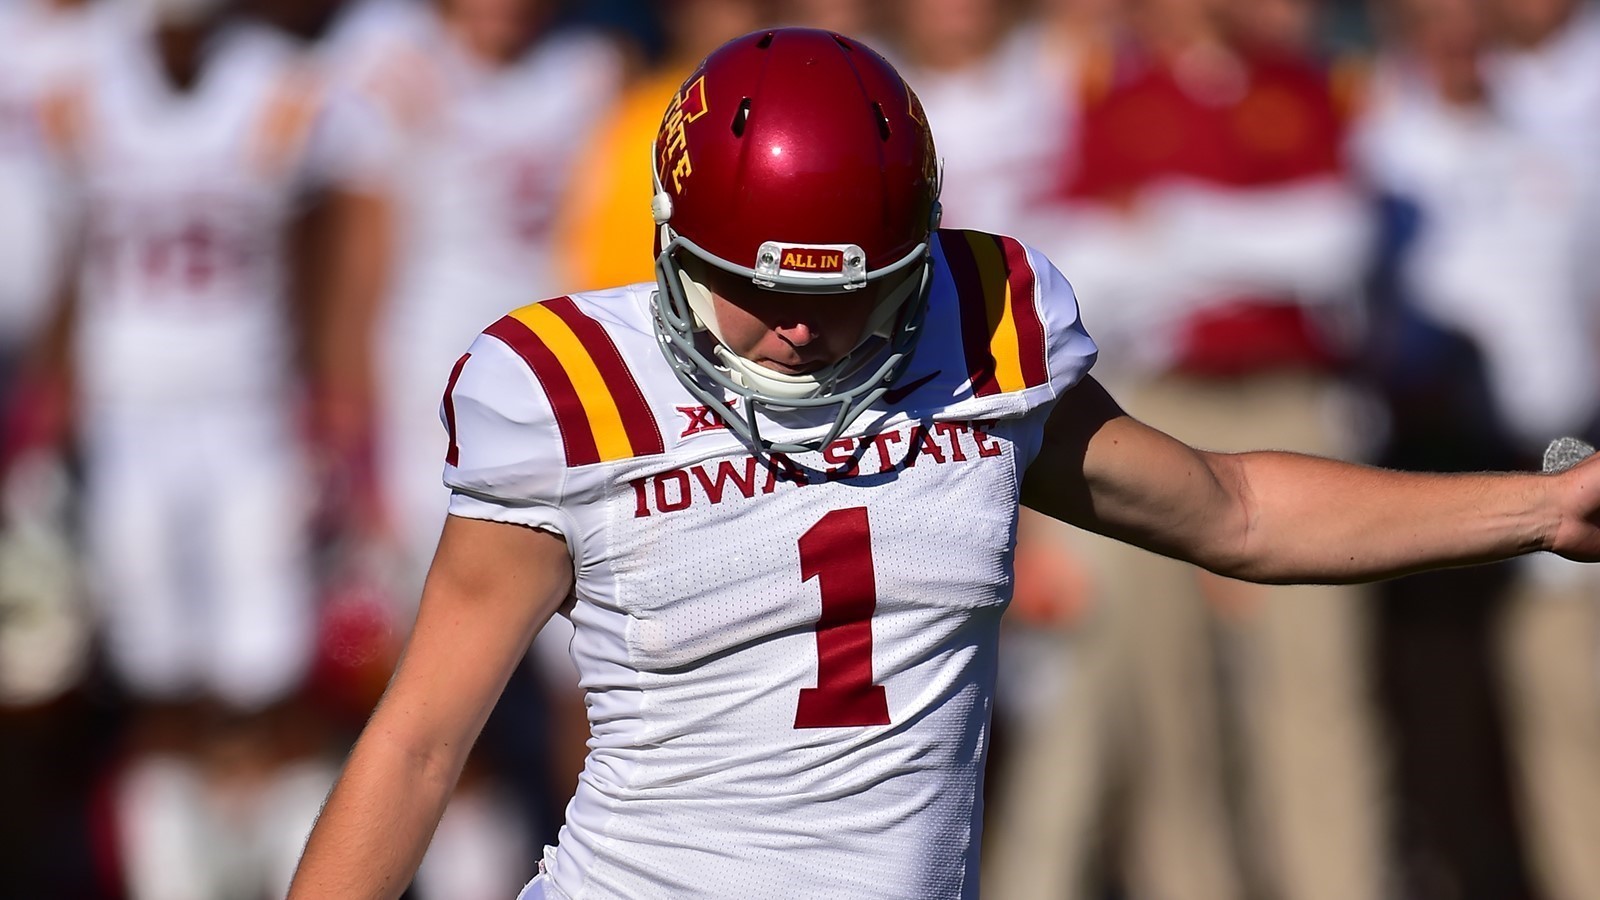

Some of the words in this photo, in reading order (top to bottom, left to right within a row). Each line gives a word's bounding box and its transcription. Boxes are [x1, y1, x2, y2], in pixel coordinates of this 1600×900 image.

[783, 252, 817, 269] ALL
[820, 255, 839, 269] IN
[629, 452, 809, 518] IOWA
[823, 419, 1002, 480] STATE
[793, 506, 892, 730] 1
